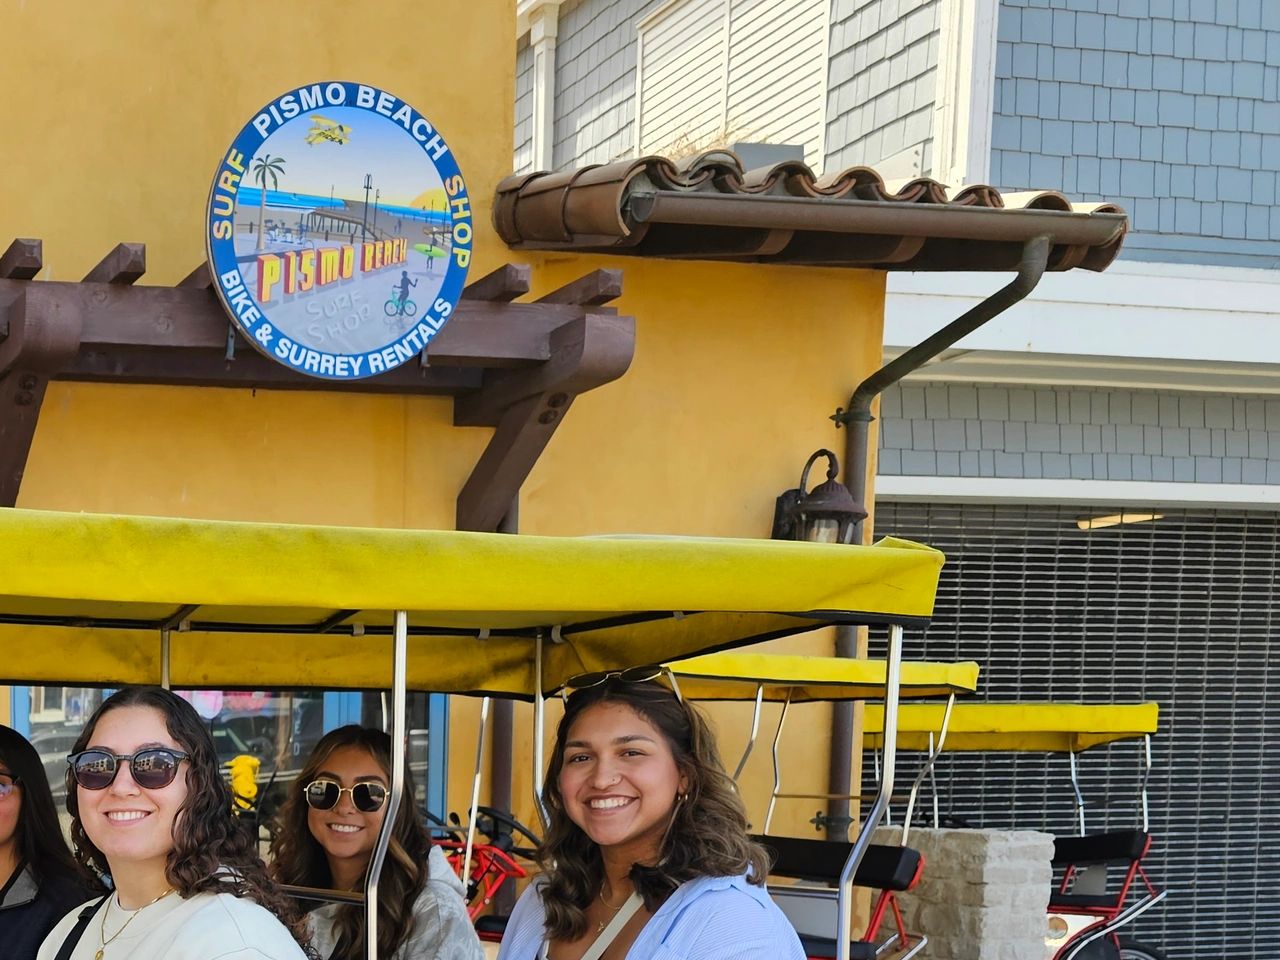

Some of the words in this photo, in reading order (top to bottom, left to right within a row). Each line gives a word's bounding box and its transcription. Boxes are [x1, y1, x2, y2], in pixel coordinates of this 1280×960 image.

[212, 148, 246, 241] SURF
[252, 82, 346, 139] PISMO
[355, 85, 448, 161] BEACH
[444, 174, 472, 269] SHOP
[219, 269, 261, 328] BIKE
[254, 322, 274, 347] &
[274, 336, 364, 376] SURREY
[368, 297, 452, 375] RENTALS
[257, 244, 355, 303] PISMO
[360, 238, 408, 273] BEACH
